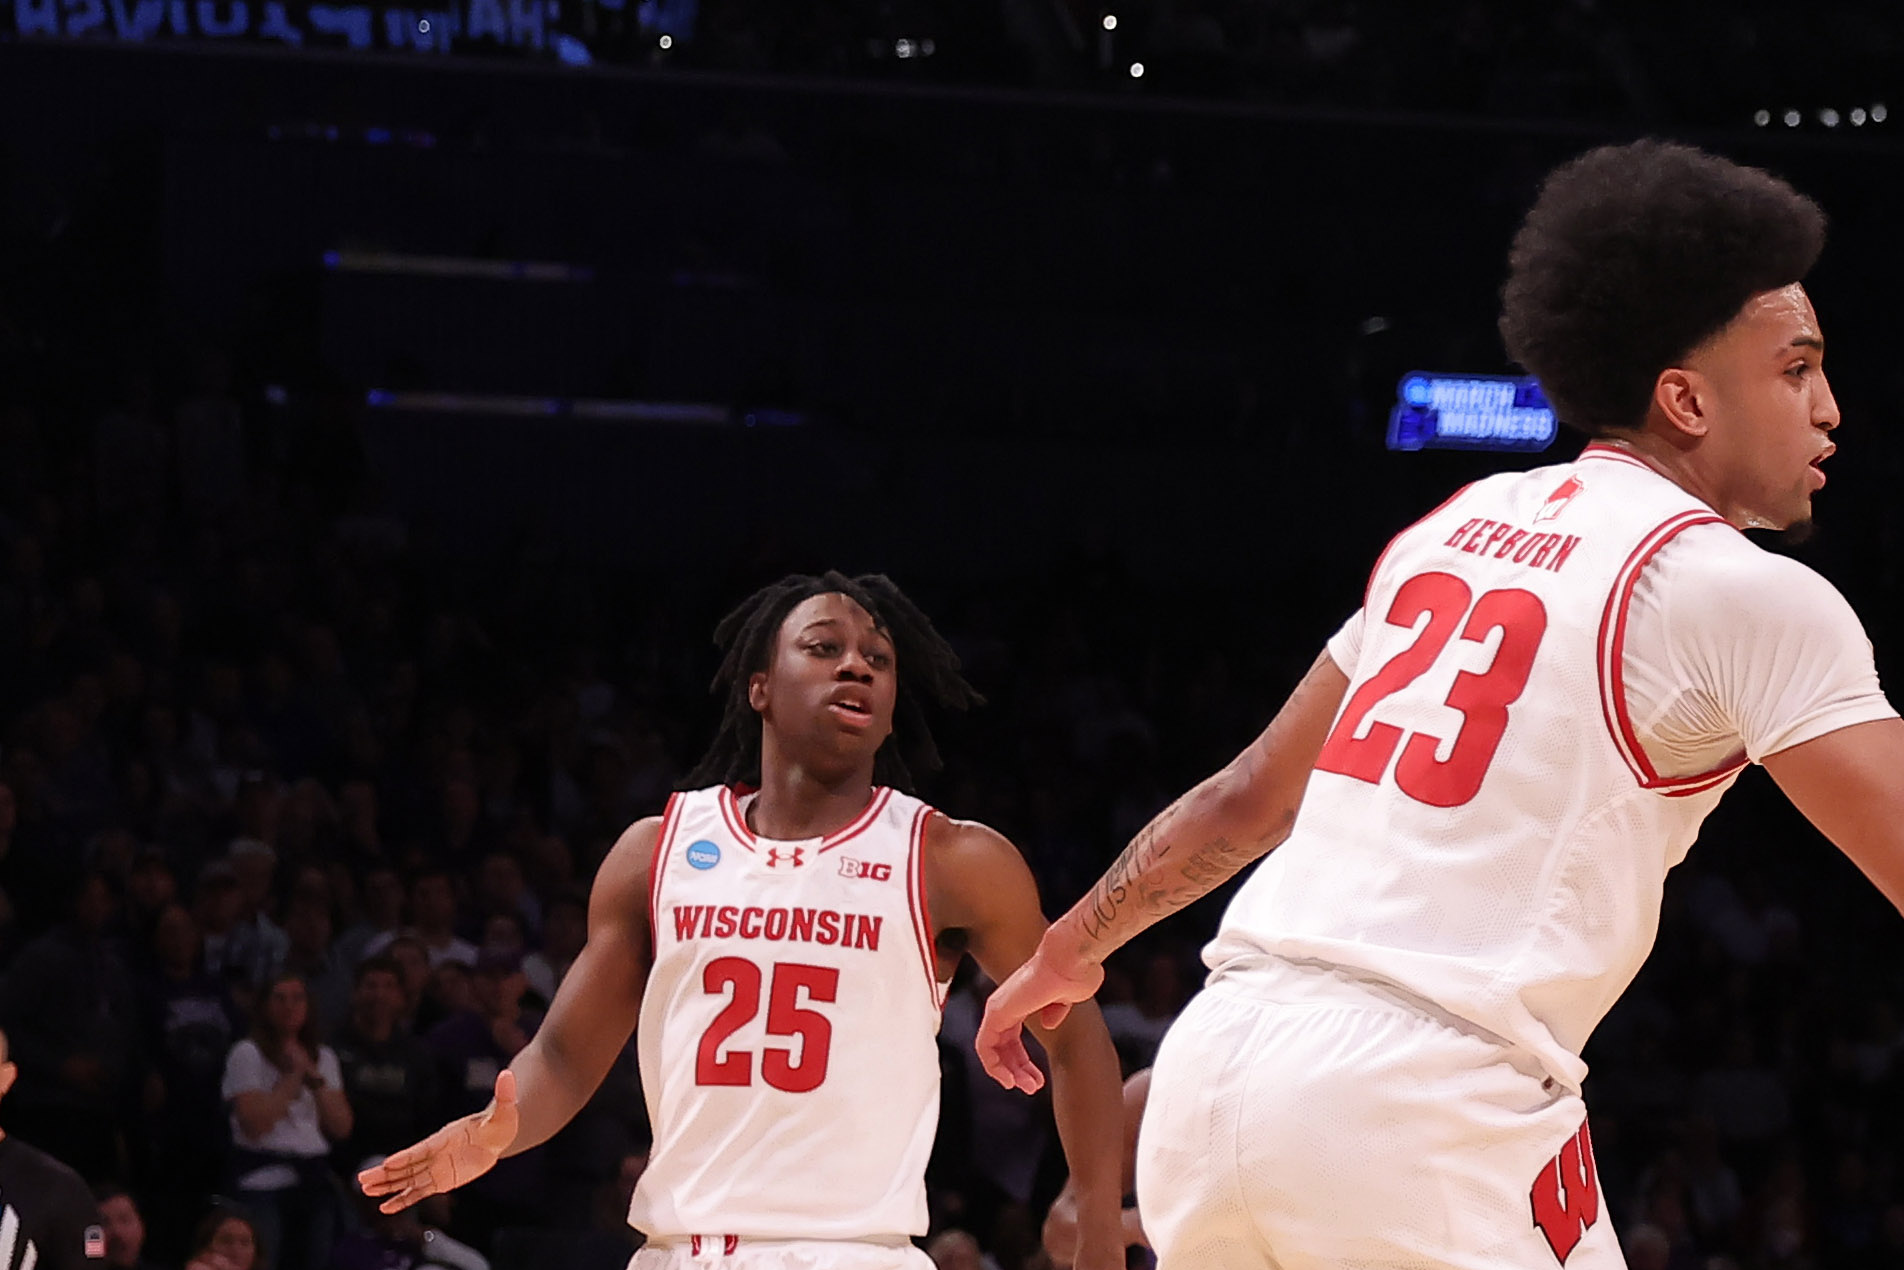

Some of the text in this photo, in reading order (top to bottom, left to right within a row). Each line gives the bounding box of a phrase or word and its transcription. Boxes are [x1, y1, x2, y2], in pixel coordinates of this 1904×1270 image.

[1315, 571, 1548, 808] 23
[673, 905, 883, 951] WISCONSIN
[695, 956, 840, 1093] 25
[1529, 1115, 1599, 1269] W
